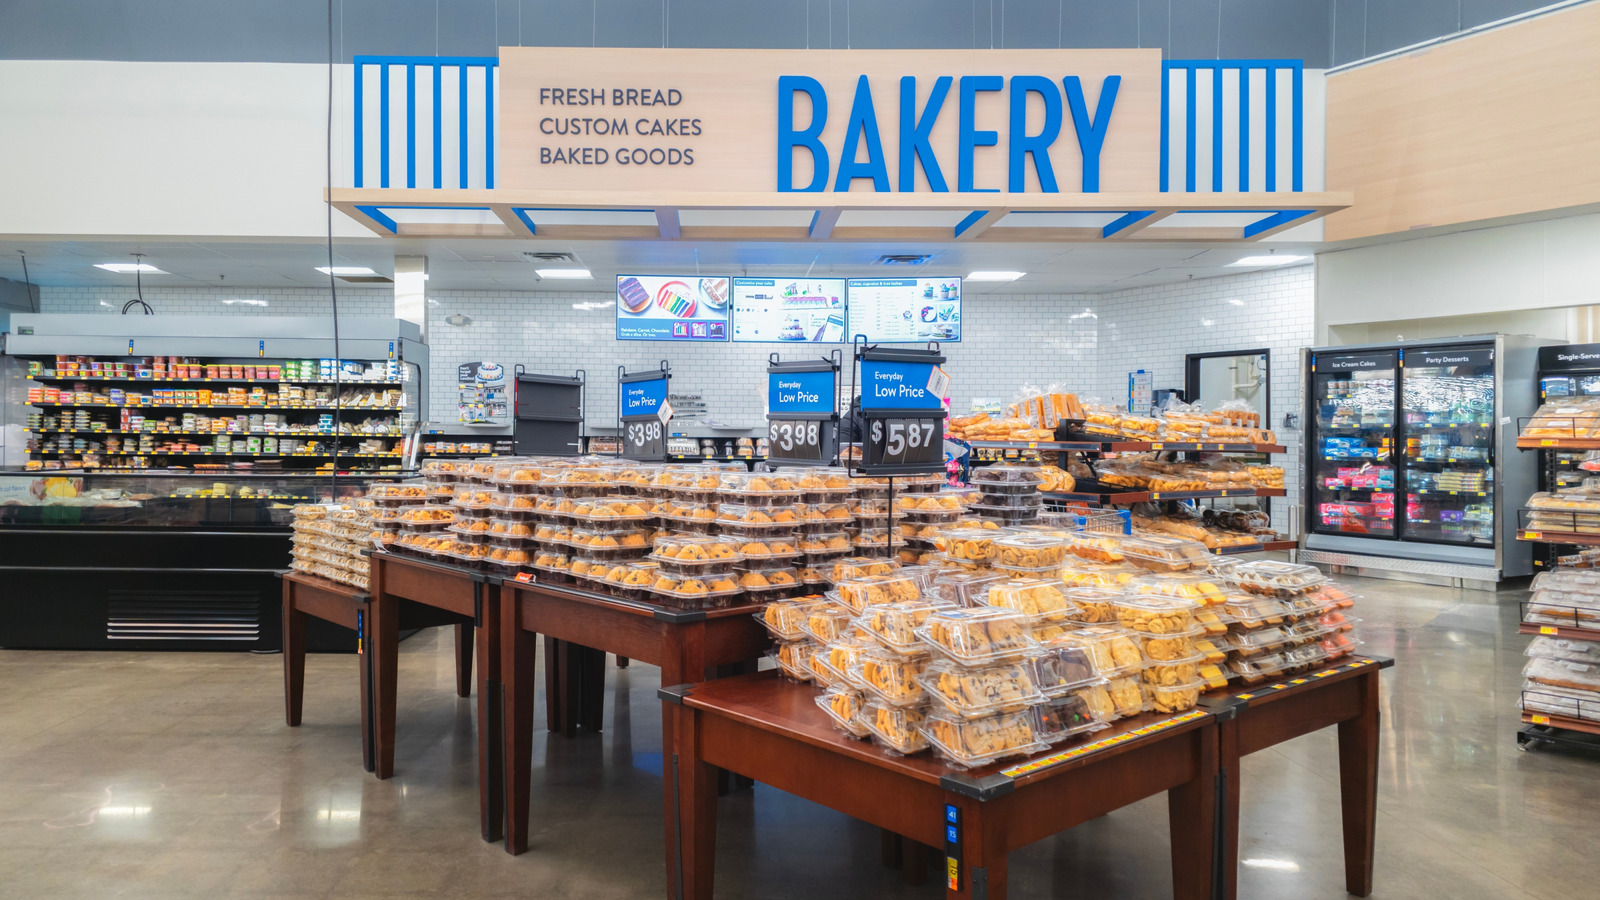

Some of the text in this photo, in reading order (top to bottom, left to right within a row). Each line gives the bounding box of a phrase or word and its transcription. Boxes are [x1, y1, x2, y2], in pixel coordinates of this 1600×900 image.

[540, 88, 682, 106] FRESH BREAD
[540, 118, 702, 136] CUSTOM CAKES
[777, 74, 1122, 193] BAKERY
[540, 147, 694, 165] BAKED GOODS
[874, 371, 903, 381] Everyday
[778, 381, 801, 389] Everyday
[875, 384, 924, 397] Low Price
[629, 397, 656, 407] Low Price
[779, 391, 819, 402] Low Price
[949, 811, 956, 819] 41
